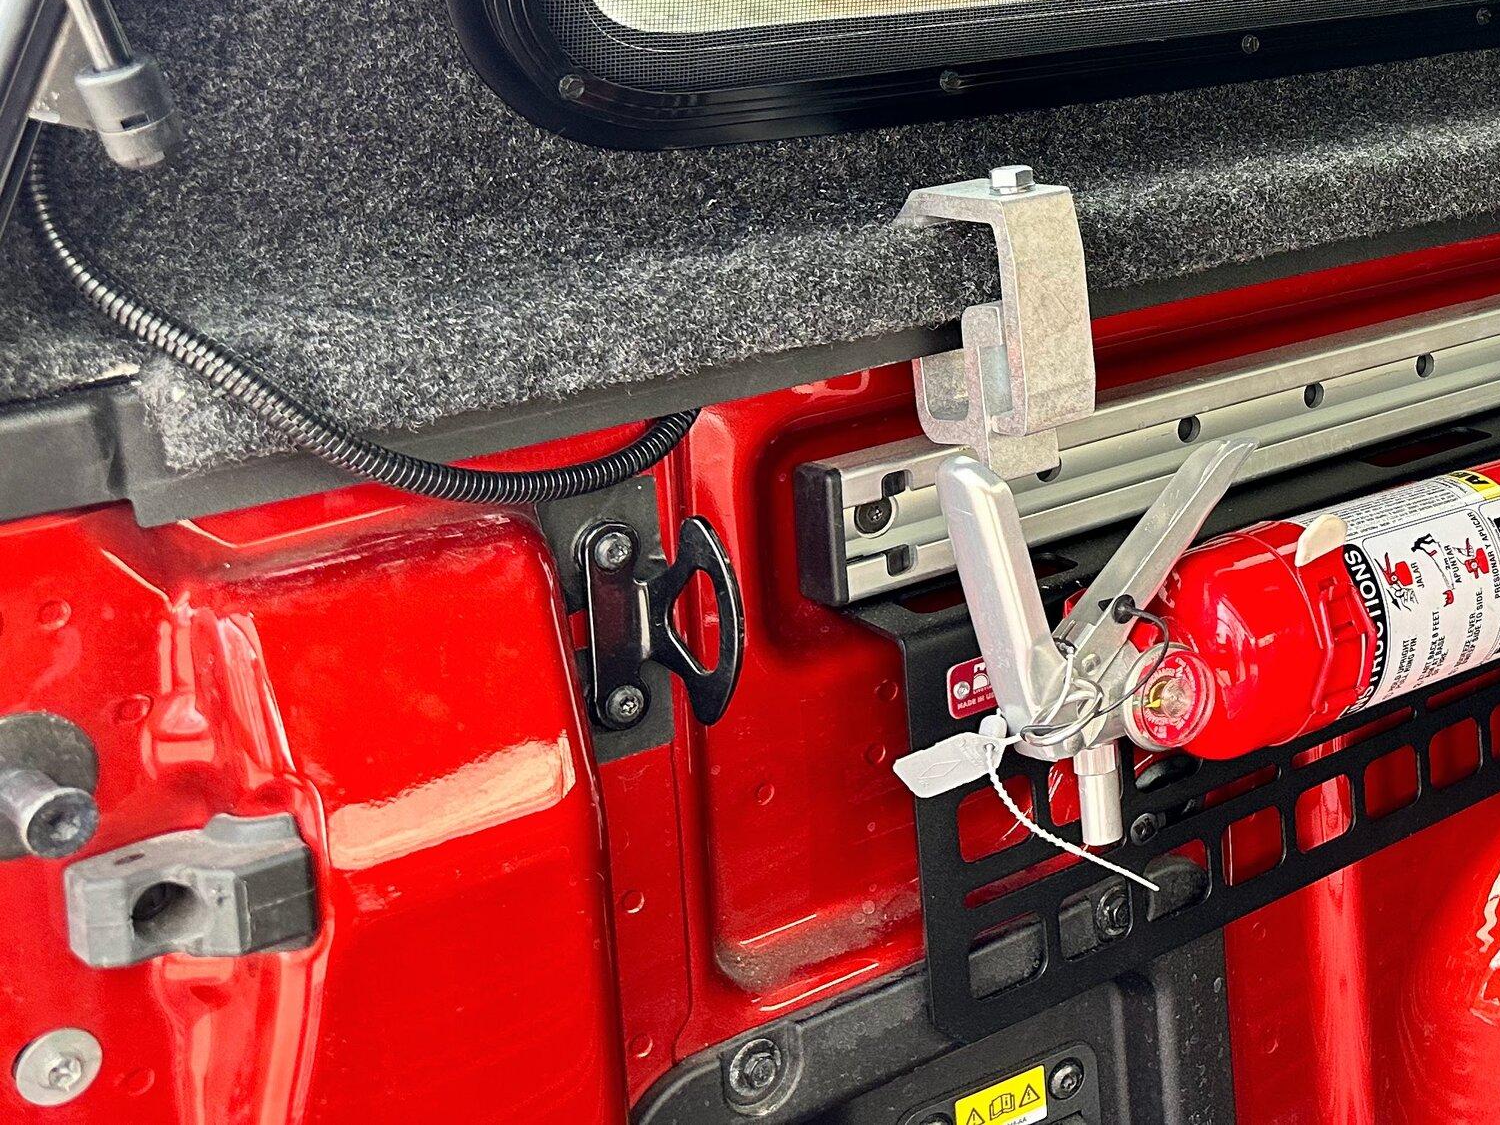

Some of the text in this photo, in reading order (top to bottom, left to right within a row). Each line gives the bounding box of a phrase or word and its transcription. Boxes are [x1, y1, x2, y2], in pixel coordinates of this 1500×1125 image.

[1466, 512, 1489, 542] APLICAR
[1411, 562, 1425, 588] JALAR
[1443, 544, 1462, 584] APUNTAR
[1487, 551, 1500, 599] PRESIONAR
[1467, 612, 1476, 638] LEVER
[1475, 612, 1483, 623] TO
[1427, 640, 1437, 661] BACK
[1432, 611, 1440, 632] FEET
[1435, 635, 1446, 656] BASE
[1471, 625, 1482, 643] SIDE
[1397, 639, 1410, 675] UPRIGHT
[1403, 654, 1415, 673] RING
